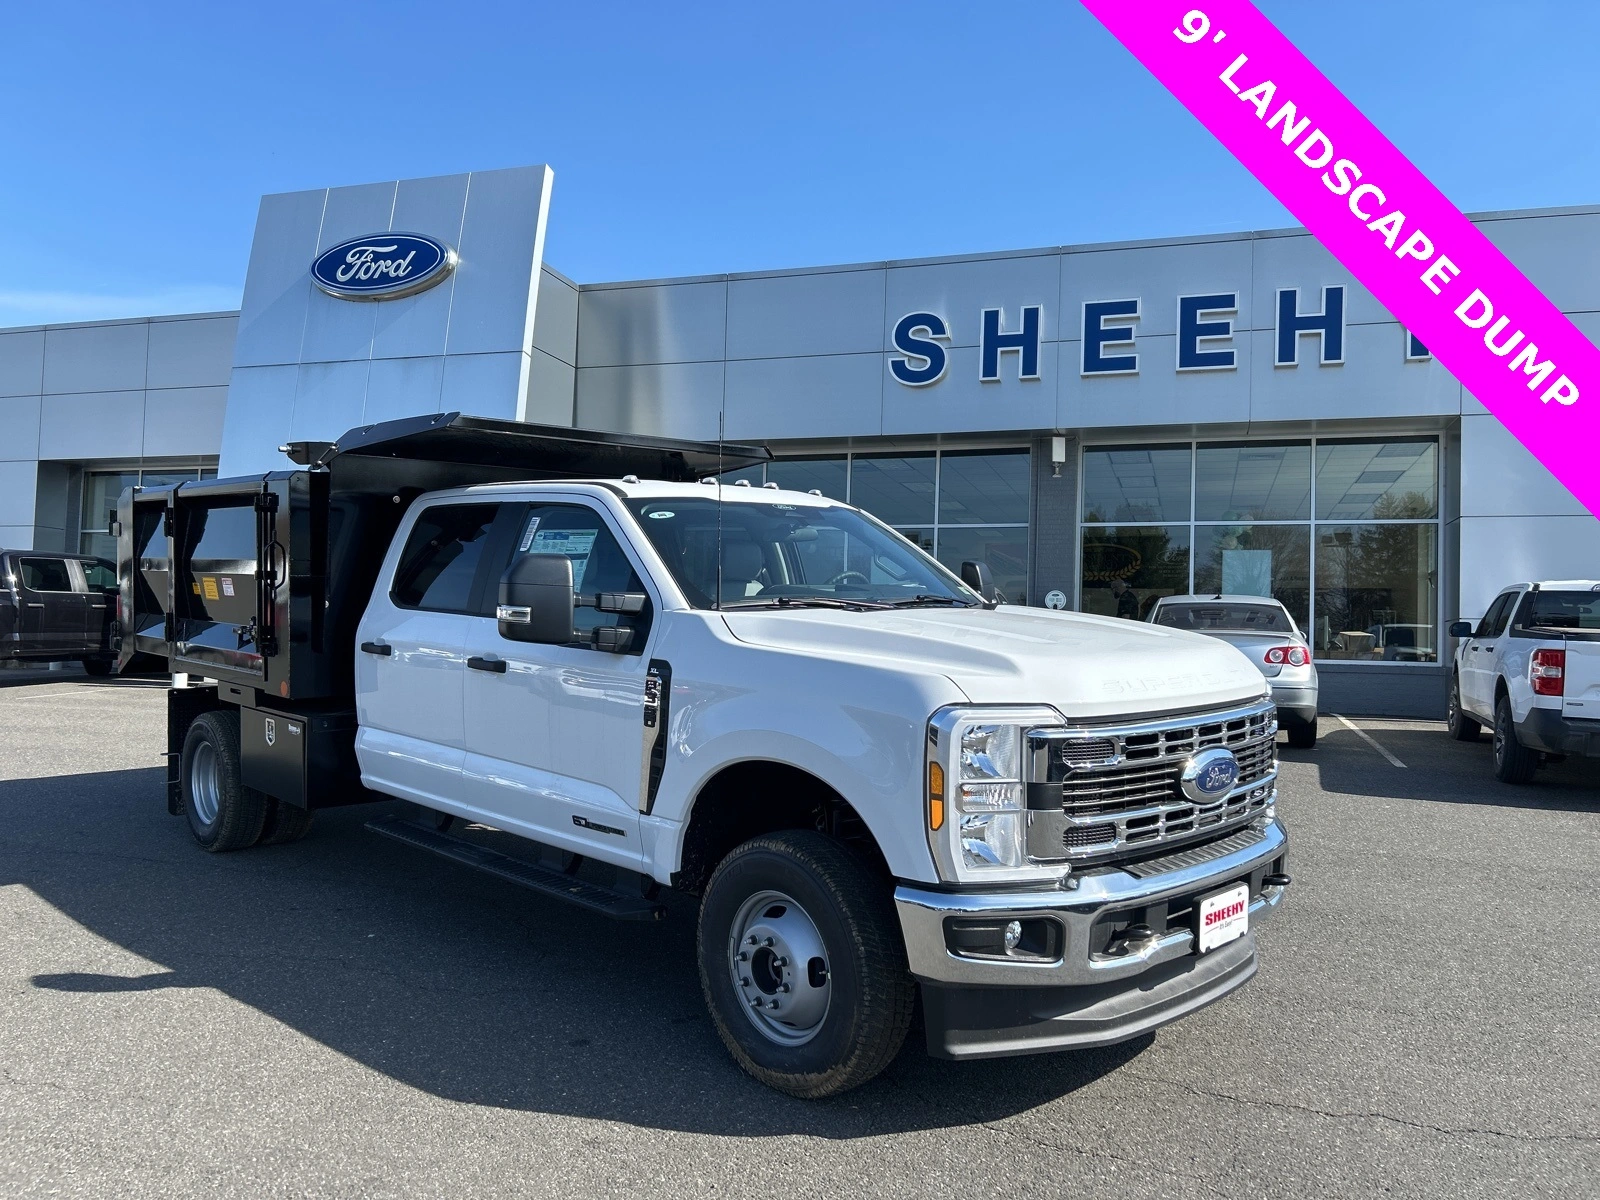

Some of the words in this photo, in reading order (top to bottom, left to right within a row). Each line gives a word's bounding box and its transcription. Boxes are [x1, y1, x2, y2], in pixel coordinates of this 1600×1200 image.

[336, 244, 417, 283] Ford
[888, 283, 1432, 387] SHEEH
[1206, 764, 1232, 789] Ford
[1205, 900, 1245, 927] SHEEHY
